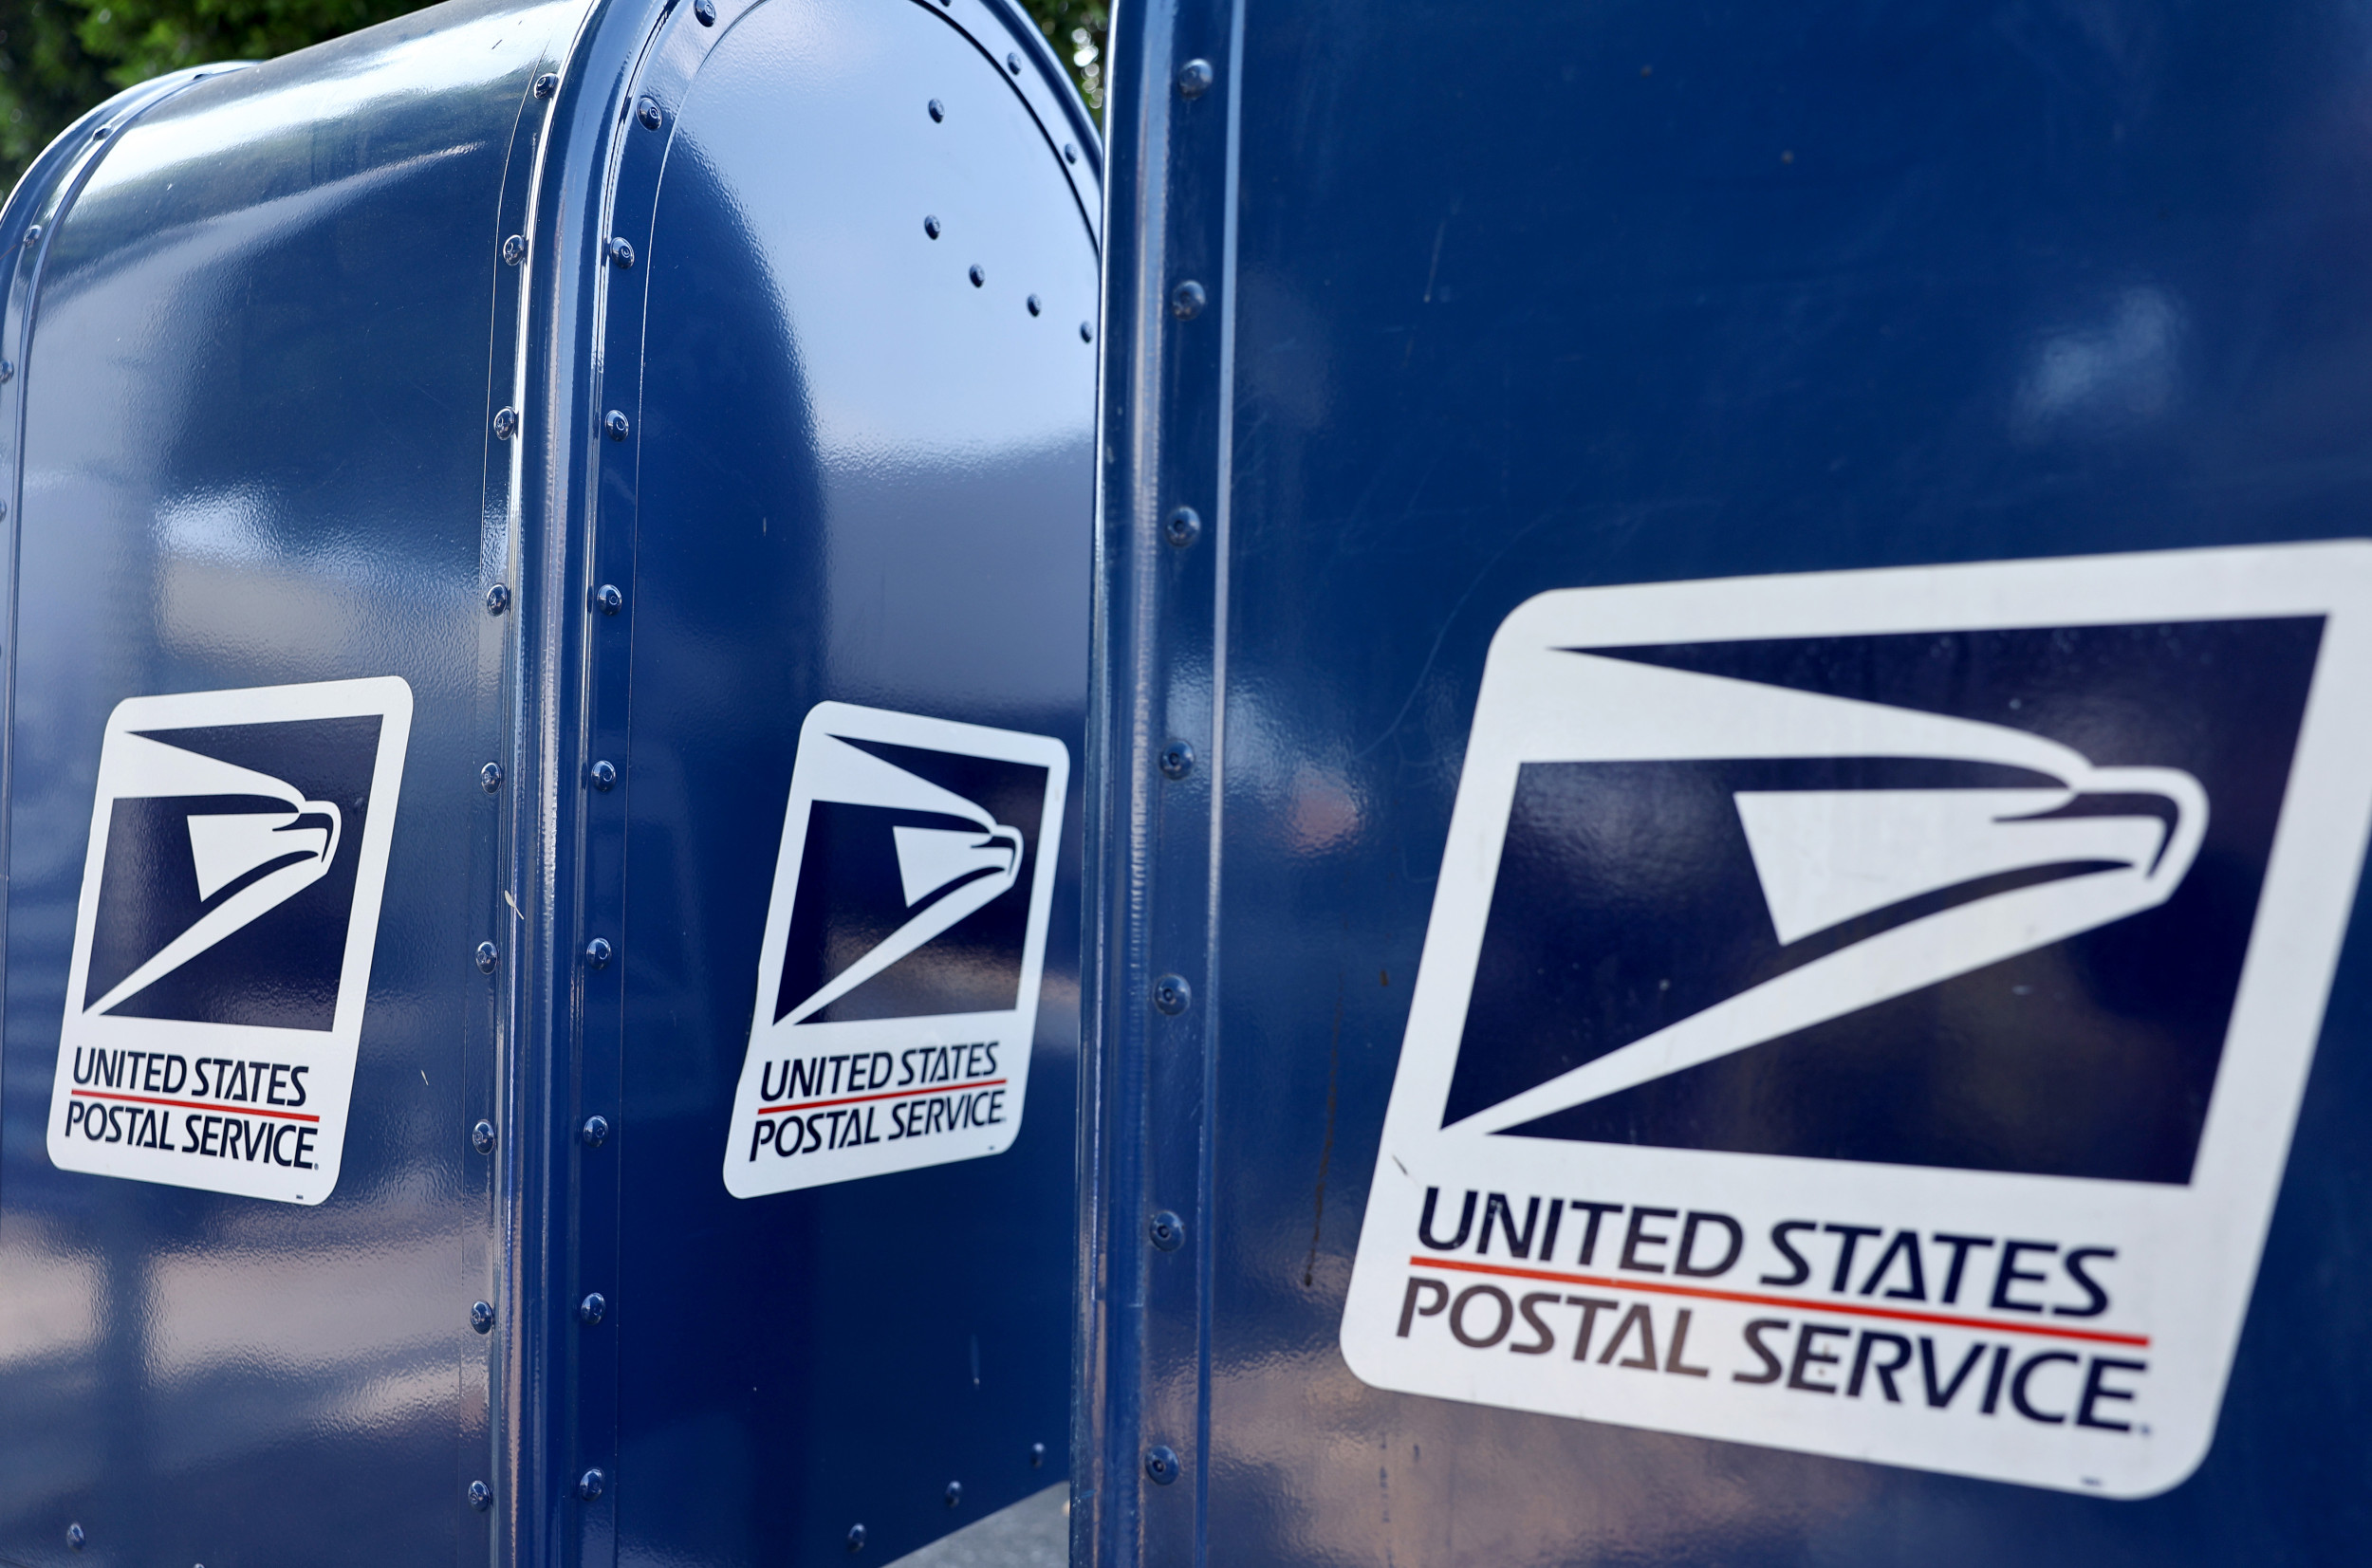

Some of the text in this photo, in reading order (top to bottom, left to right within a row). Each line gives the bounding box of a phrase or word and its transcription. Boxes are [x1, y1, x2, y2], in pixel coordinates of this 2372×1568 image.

[73, 1046, 308, 1106] UNITED STATES
[761, 1042, 999, 1101] UNITED STATES
[65, 1100, 318, 1170] POSTAL SERVICE
[750, 1090, 1006, 1161] POSTAL SERVICE
[1417, 1187, 2116, 1319] UNITED STATES
[1395, 1276, 2148, 1432] POSTAL SERVICE
